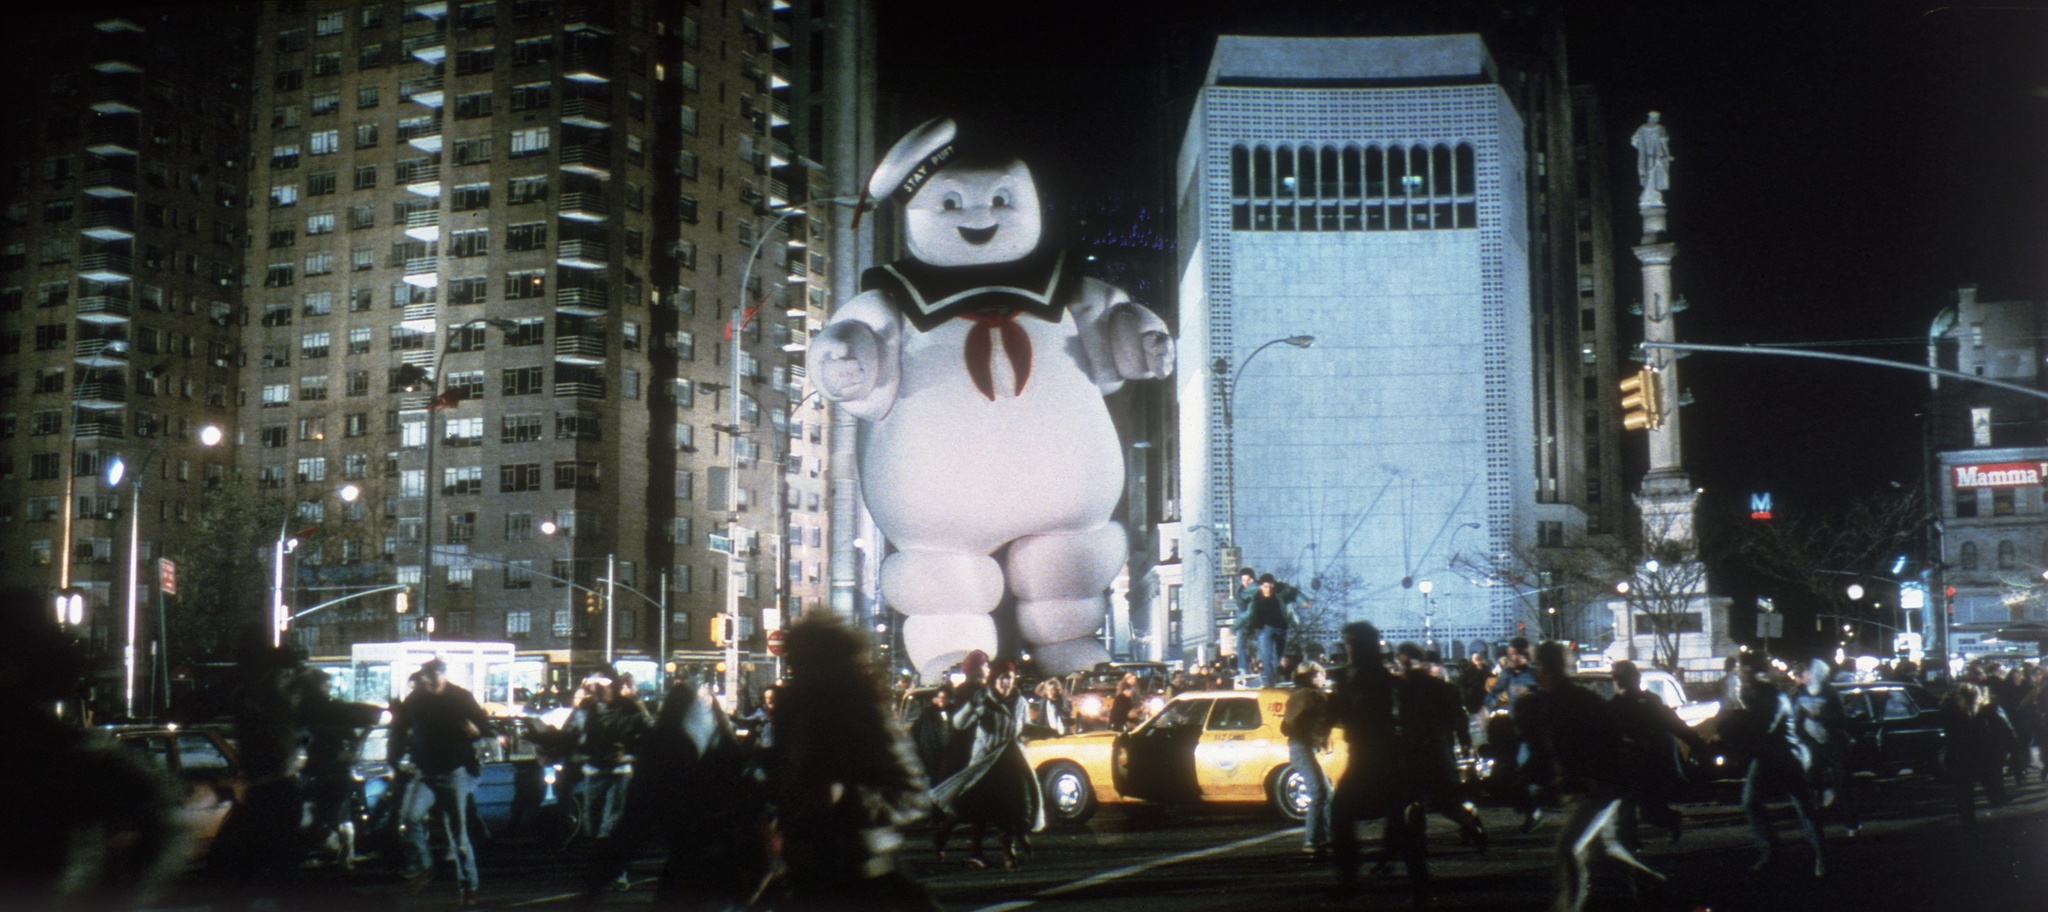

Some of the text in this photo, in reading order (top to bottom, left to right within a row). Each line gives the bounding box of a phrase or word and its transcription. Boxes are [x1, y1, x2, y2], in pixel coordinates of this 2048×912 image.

[903, 165, 927, 192] STAY
[1956, 466, 2039, 487] Mamma
[1751, 493, 1771, 511] M
